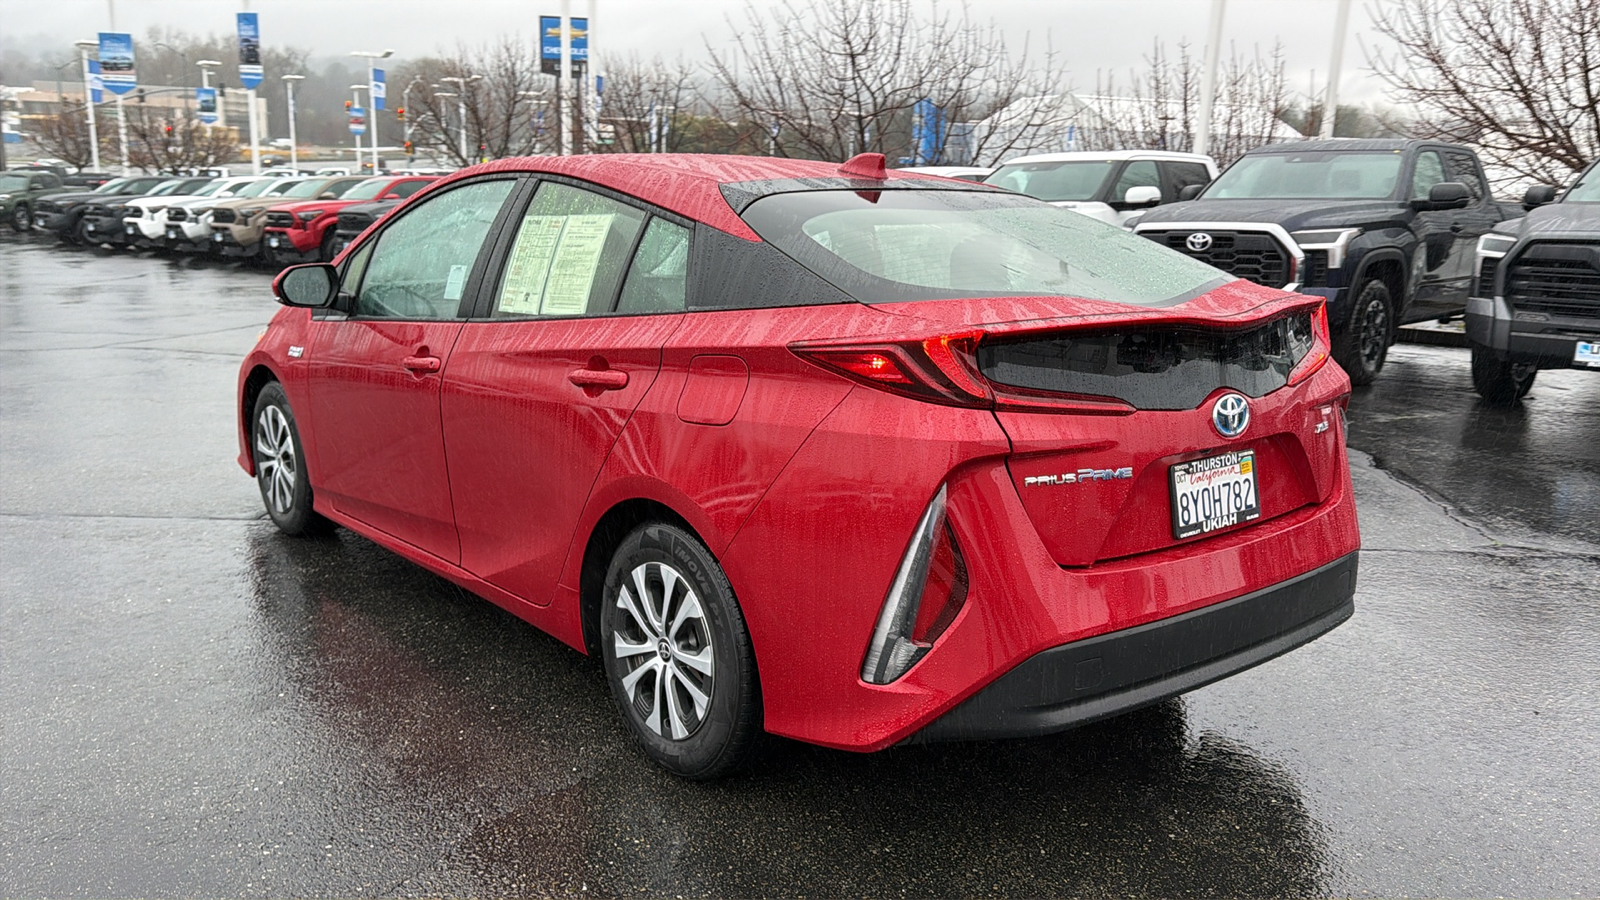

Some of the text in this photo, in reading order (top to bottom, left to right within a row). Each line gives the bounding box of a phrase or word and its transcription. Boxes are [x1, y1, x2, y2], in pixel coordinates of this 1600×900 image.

[1192, 453, 1237, 473] THURSTON
[1024, 467, 1133, 487] PRIUS PRIME
[1190, 466, 1240, 486] California
[1202, 512, 1237, 533] UKIAH
